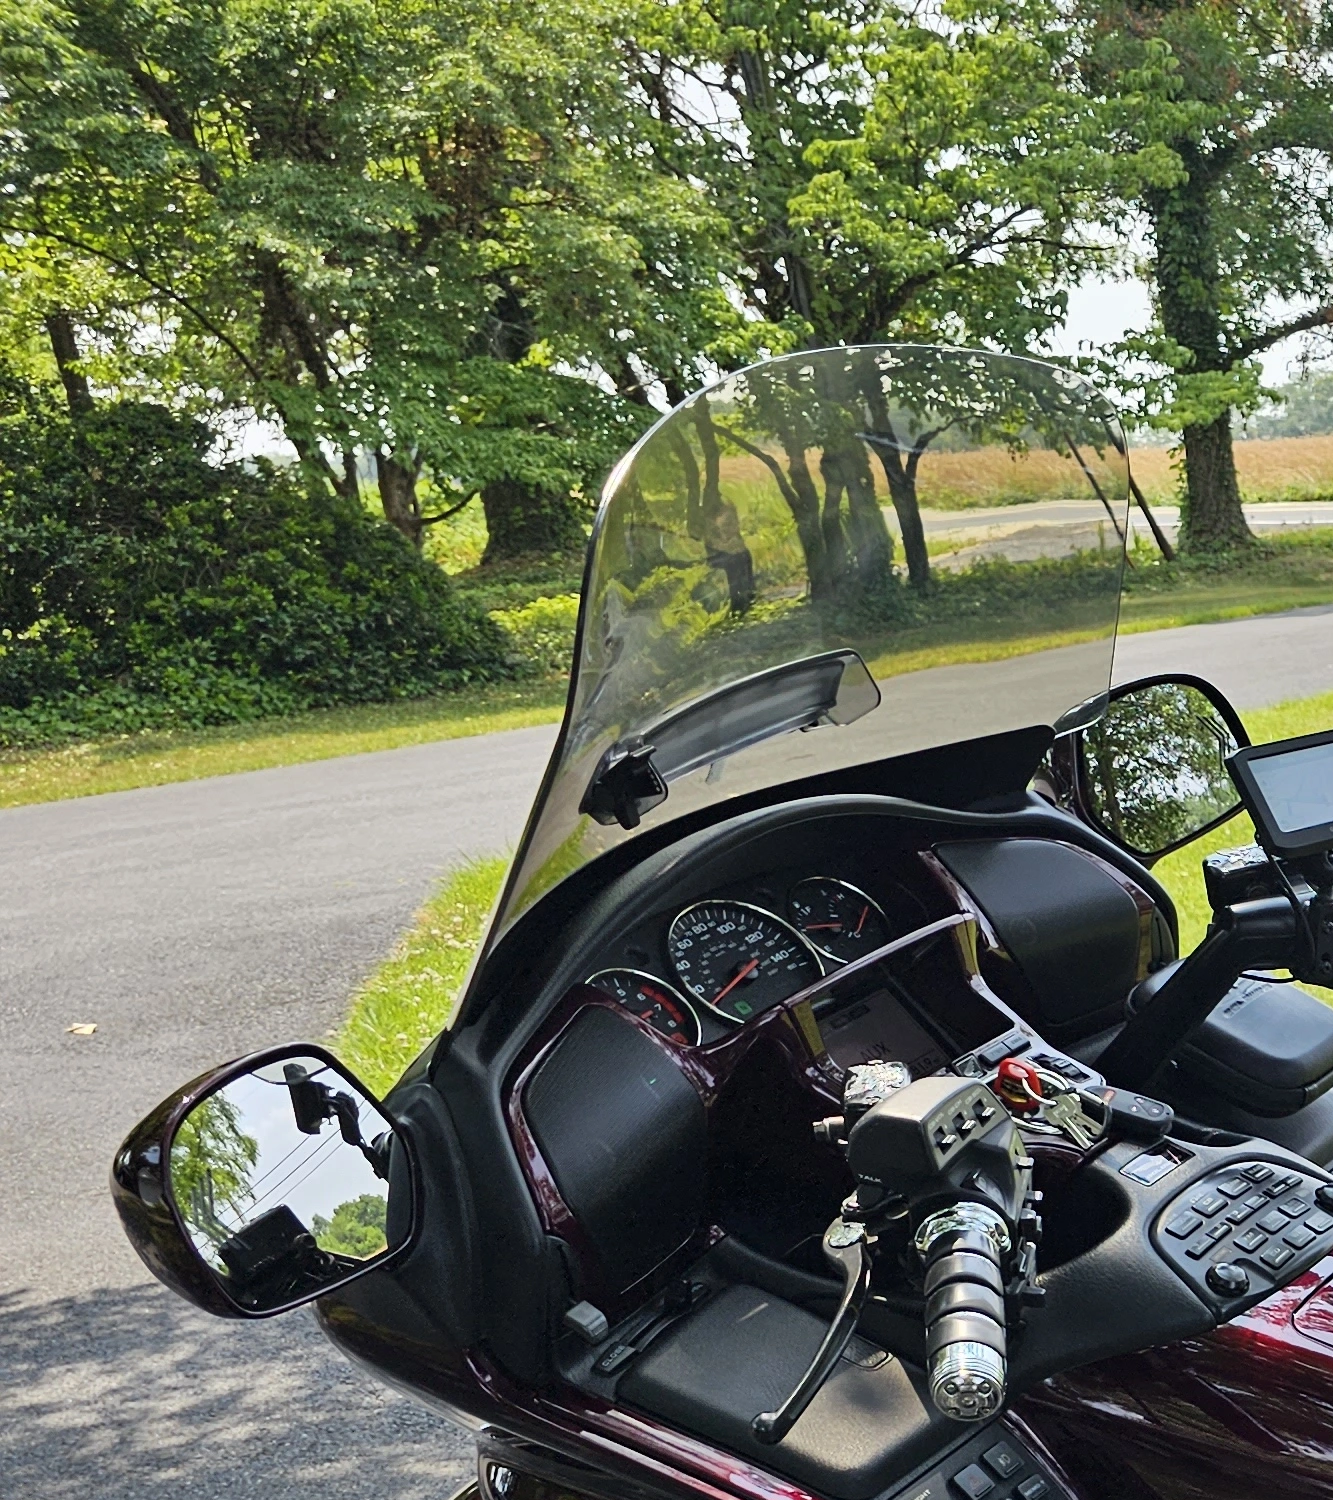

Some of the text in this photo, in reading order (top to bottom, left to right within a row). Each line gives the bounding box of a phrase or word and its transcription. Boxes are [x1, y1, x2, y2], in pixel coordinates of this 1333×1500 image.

[691, 922, 708, 935] 80
[716, 921, 736, 934] 100
[744, 930, 764, 944] 120
[676, 938, 693, 950] 60
[770, 949, 790, 963] 140
[675, 959, 691, 972] 40
[653, 1002, 662, 1011] 7
[860, 1041, 891, 1061] AUX
